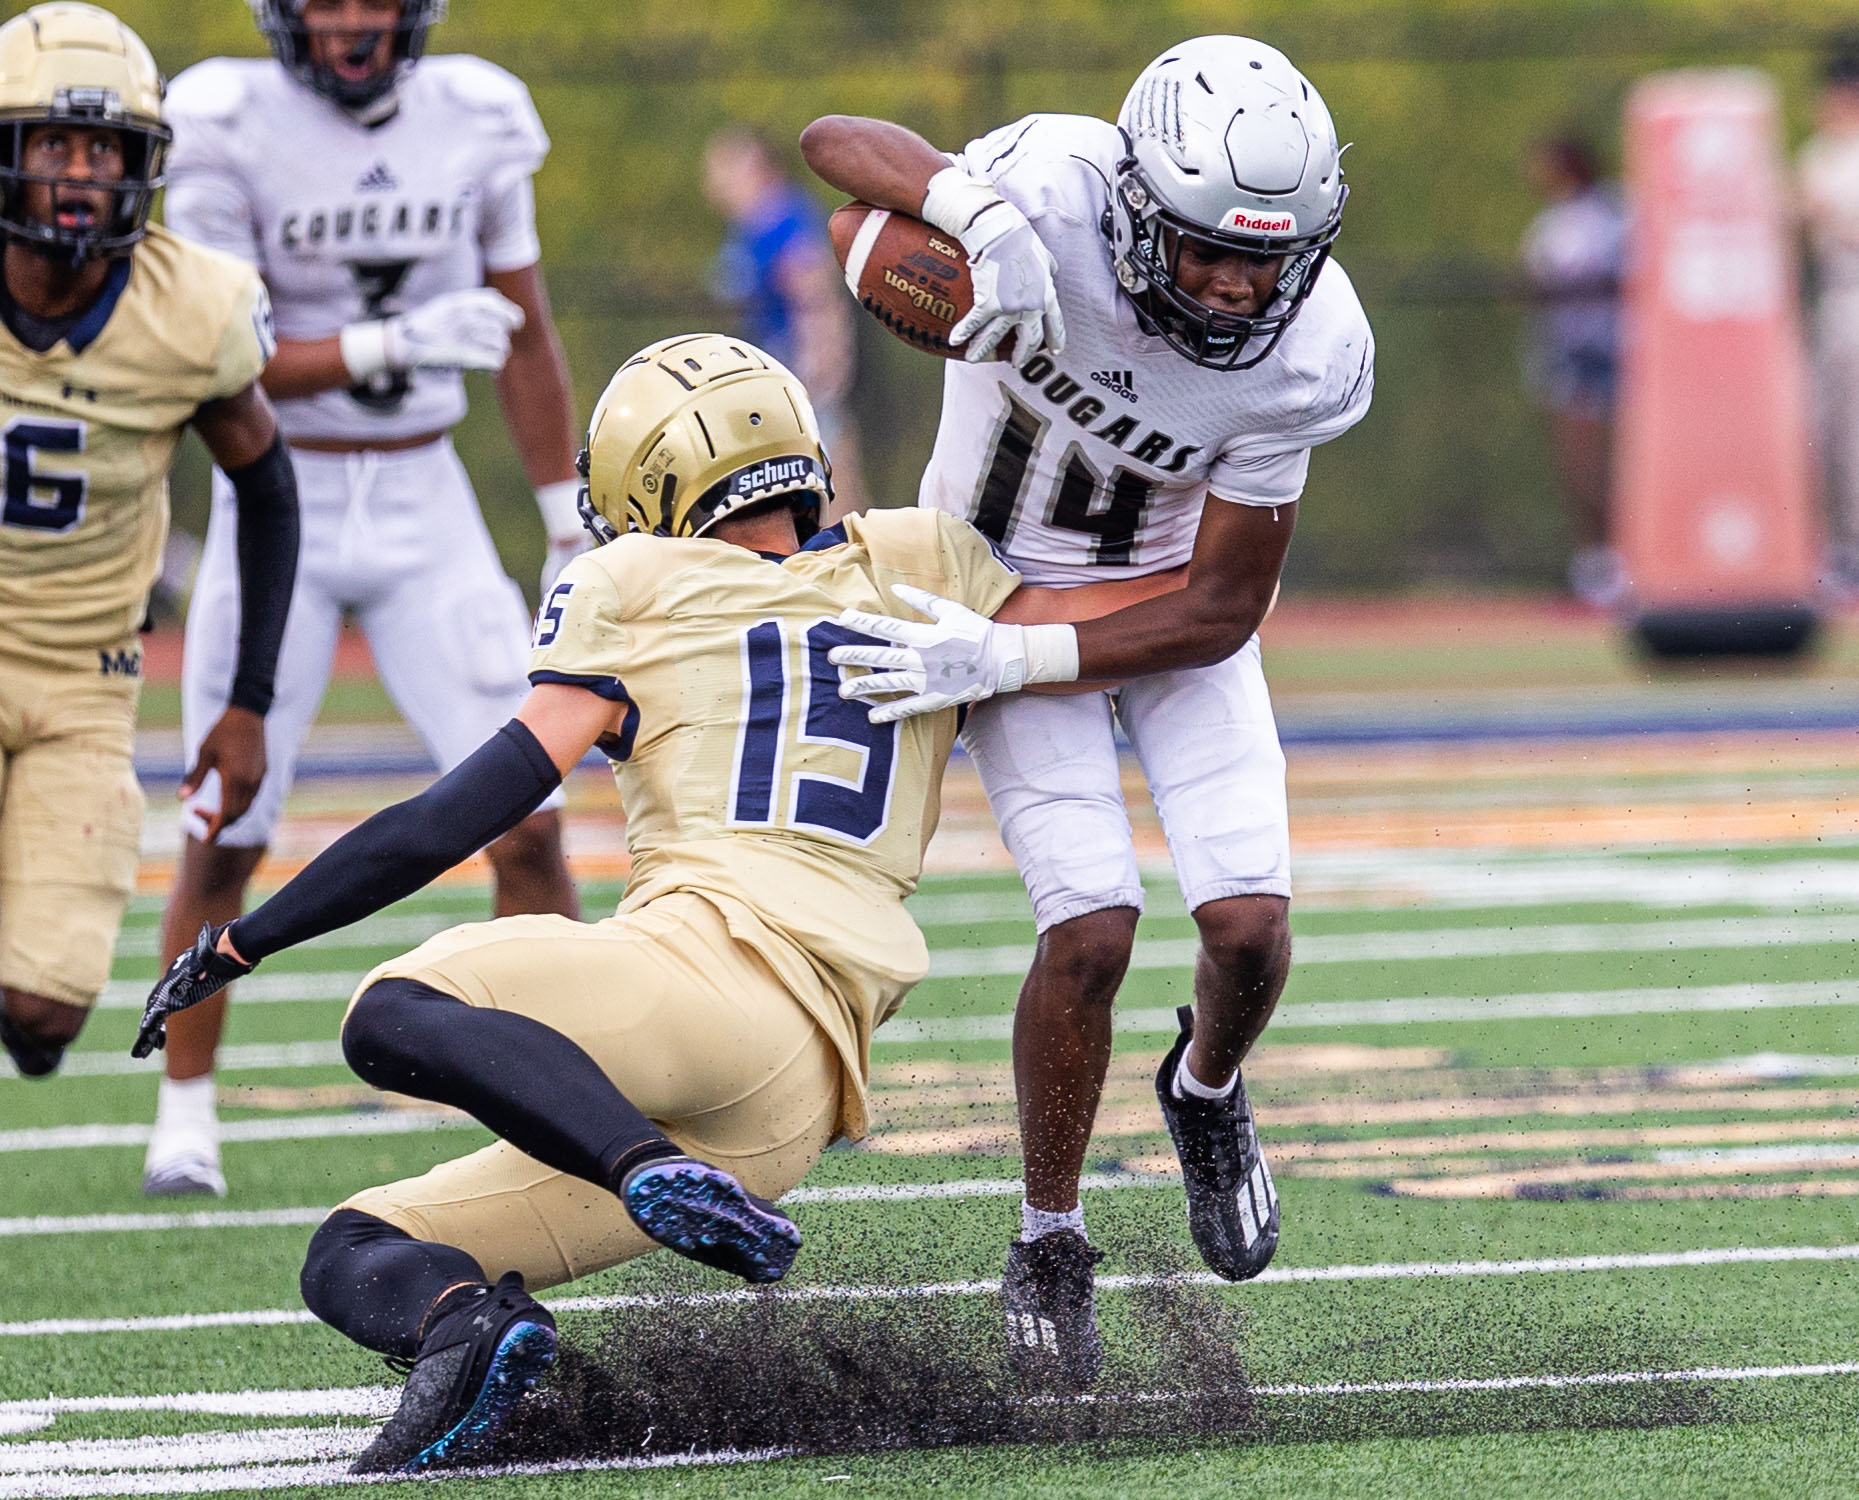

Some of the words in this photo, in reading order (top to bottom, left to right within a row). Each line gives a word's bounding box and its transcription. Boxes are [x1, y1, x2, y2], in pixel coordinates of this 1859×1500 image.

[1234, 214, 1291, 232] Riddell
[884, 269, 957, 323] Wilson
[1018, 354, 1205, 474] OUGARS
[1090, 371, 1139, 404] adidas
[1, 413, 87, 536] 6
[738, 458, 806, 494] schutt
[965, 380, 1166, 566] 14
[531, 582, 577, 652] 5
[727, 616, 902, 848] 15
